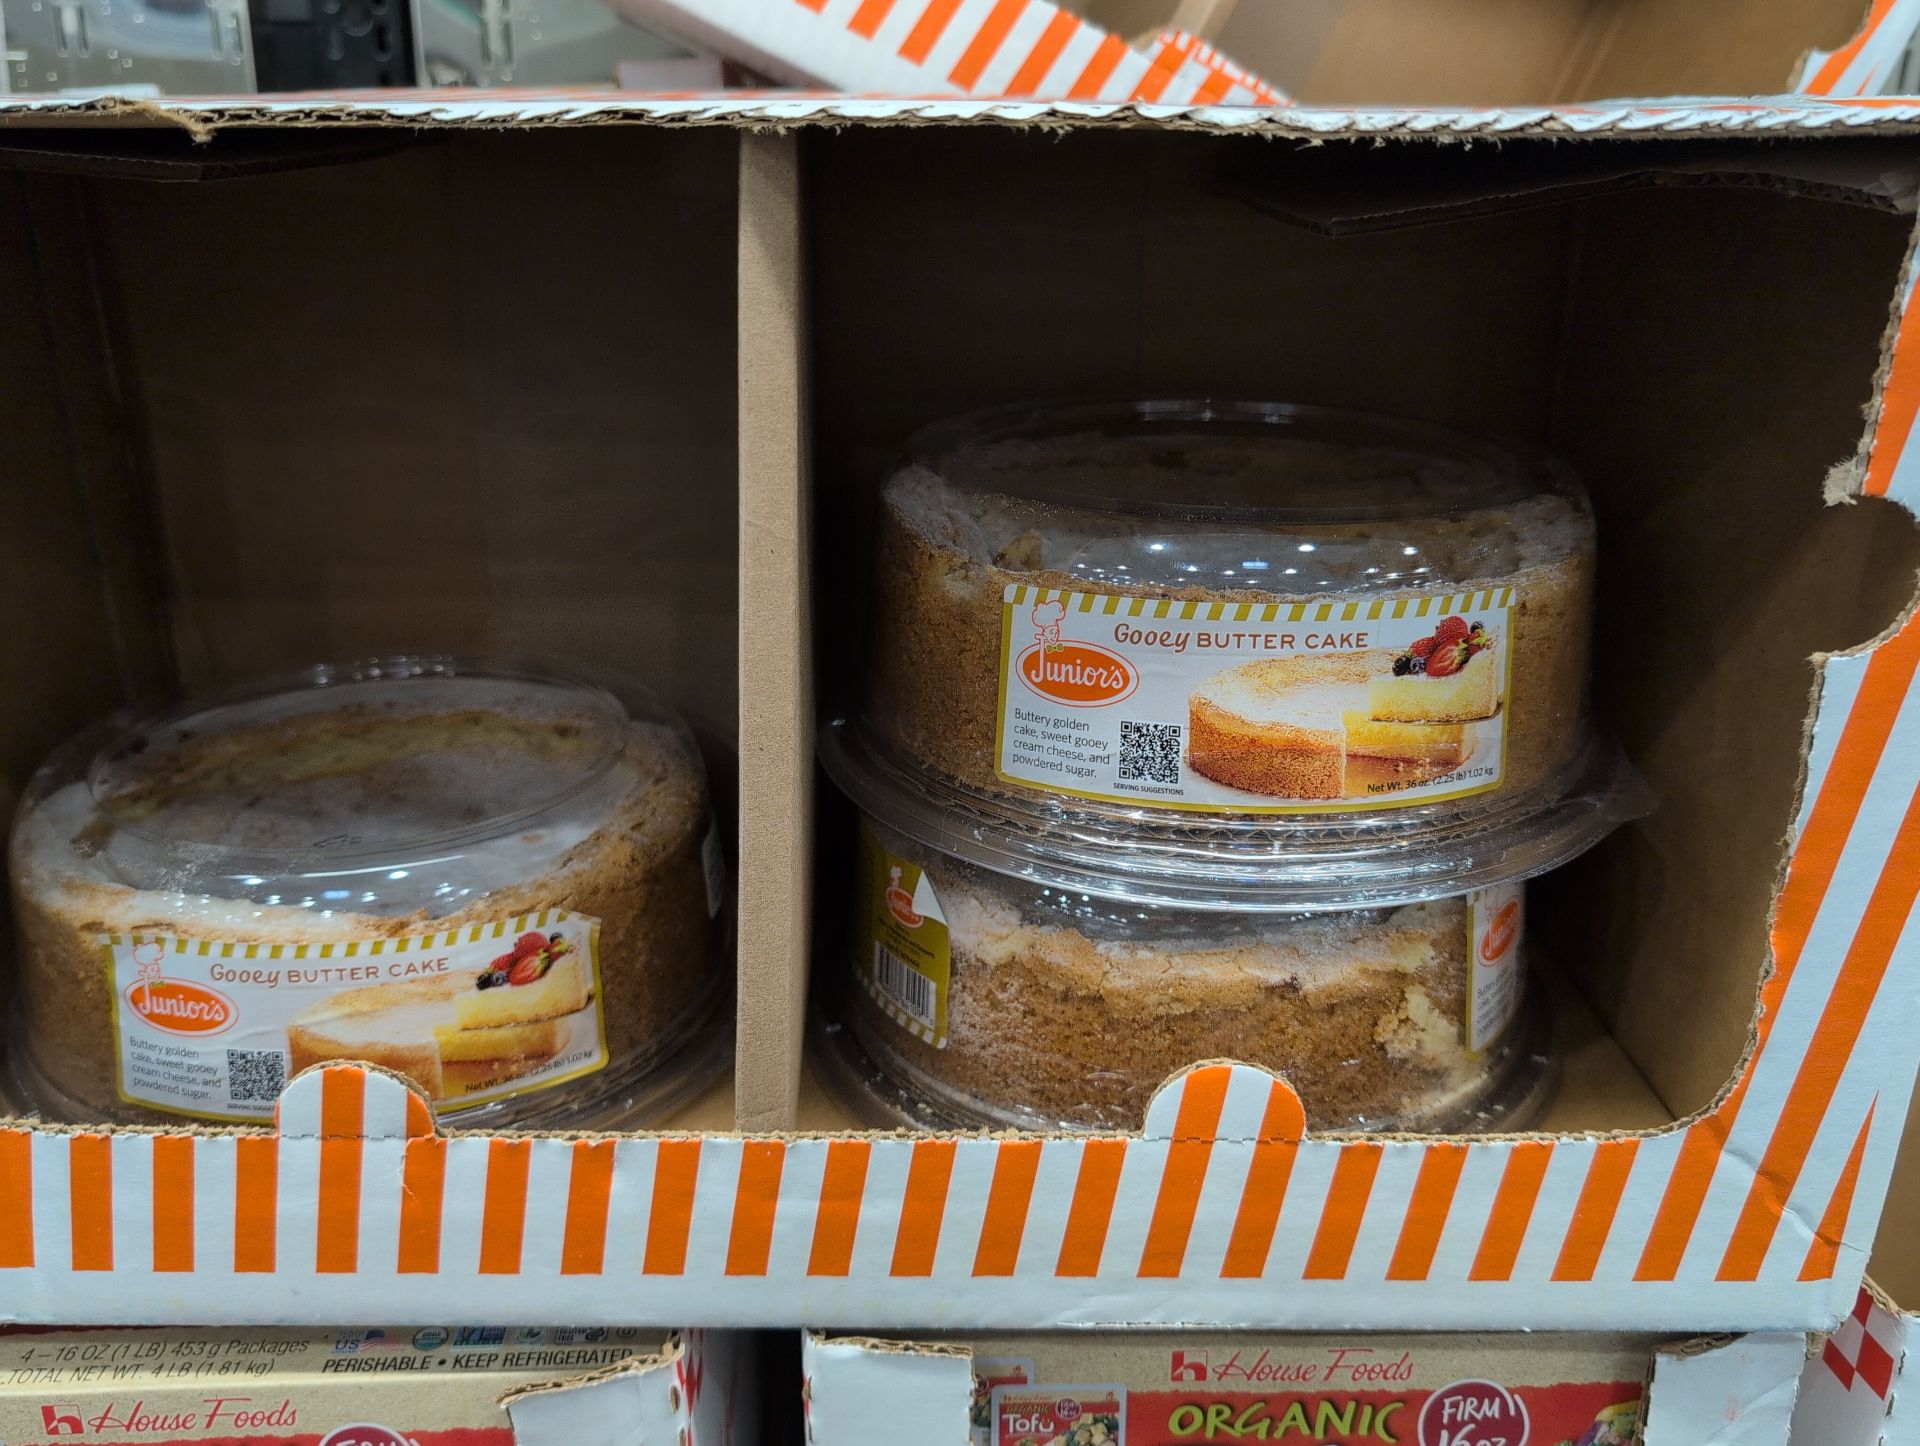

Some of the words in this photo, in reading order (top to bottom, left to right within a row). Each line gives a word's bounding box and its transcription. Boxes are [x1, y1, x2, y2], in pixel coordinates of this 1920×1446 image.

[1114, 622, 1190, 652] Gooey
[1197, 632, 1295, 650] BUTTER
[1305, 632, 1368, 649] CAKE
[1031, 634, 1124, 689] Junior's
[1015, 708, 1050, 727] Buttery
[1053, 718, 1089, 732] golden
[1014, 725, 1038, 740] cake,
[1041, 731, 1072, 744] sweet
[1075, 737, 1108, 751] gooey
[1014, 739, 1044, 754] cream
[1046, 745, 1086, 762] cheese,
[1089, 753, 1110, 765] and
[1012, 753, 1063, 772] powdered
[1065, 763, 1097, 778] sugar.
[1113, 782, 1139, 792] SERVING
[1140, 786, 1184, 796] SUGGESTIONS
[1367, 783, 1384, 793] Net
[1386, 781, 1404, 791] Wt.
[1405, 780, 1416, 790] 36
[1433, 773, 1455, 785] (2.25
[1456, 770, 1467, 780] lb)
[1468, 768, 1483, 778] 1.02
[1484, 766, 1493, 776] kg
[210, 963, 280, 989] Gooey
[288, 967, 379, 983] BUTTER
[388, 957, 450, 977] CAKE
[138, 972, 225, 1021] Junior's
[130, 1036, 164, 1054] Buttery
[166, 1045, 199, 1058] golden
[132, 1051, 154, 1064] cake,
[156, 1057, 185, 1070] sweet
[187, 1063, 218, 1076] gooey
[133, 1064, 161, 1078] cream
[163, 1070, 199, 1085] cheese,
[202, 1077, 221, 1088] and
[134, 1077, 179, 1094] powdered
[182, 1088, 212, 1100] sugar.
[20, 1347, 33, 1362] 4
[55, 1345, 76, 1362] 16
[81, 1344, 104, 1361] OZ
[111, 1343, 130, 1362] (1
[134, 1341, 167, 1361] LB)
[170, 1340, 206, 1357] 453
[207, 1343, 222, 1358] g
[225, 1339, 309, 1358] Packages
[322, 1355, 433, 1373] PERISHABLE
[452, 1353, 500, 1369] KEEP
[8, 1367, 62, 1385] TOTAL
[68, 1365, 110, 1382] NET
[113, 1363, 145, 1380] WT.
[151, 1361, 165, 1377] 4
[166, 1361, 193, 1377] LB
[195, 1360, 240, 1378] (1.81
[245, 1358, 275, 1377] kg)
[1213, 1349, 1318, 1381] House
[1323, 1347, 1414, 1382] Foods
[87, 1401, 197, 1433] House
[203, 1398, 298, 1429] Foods
[1168, 1400, 1405, 1444] ORGANIC
[1442, 1395, 1500, 1424] FIRM
[1002, 1413, 1054, 1433] Tofu
